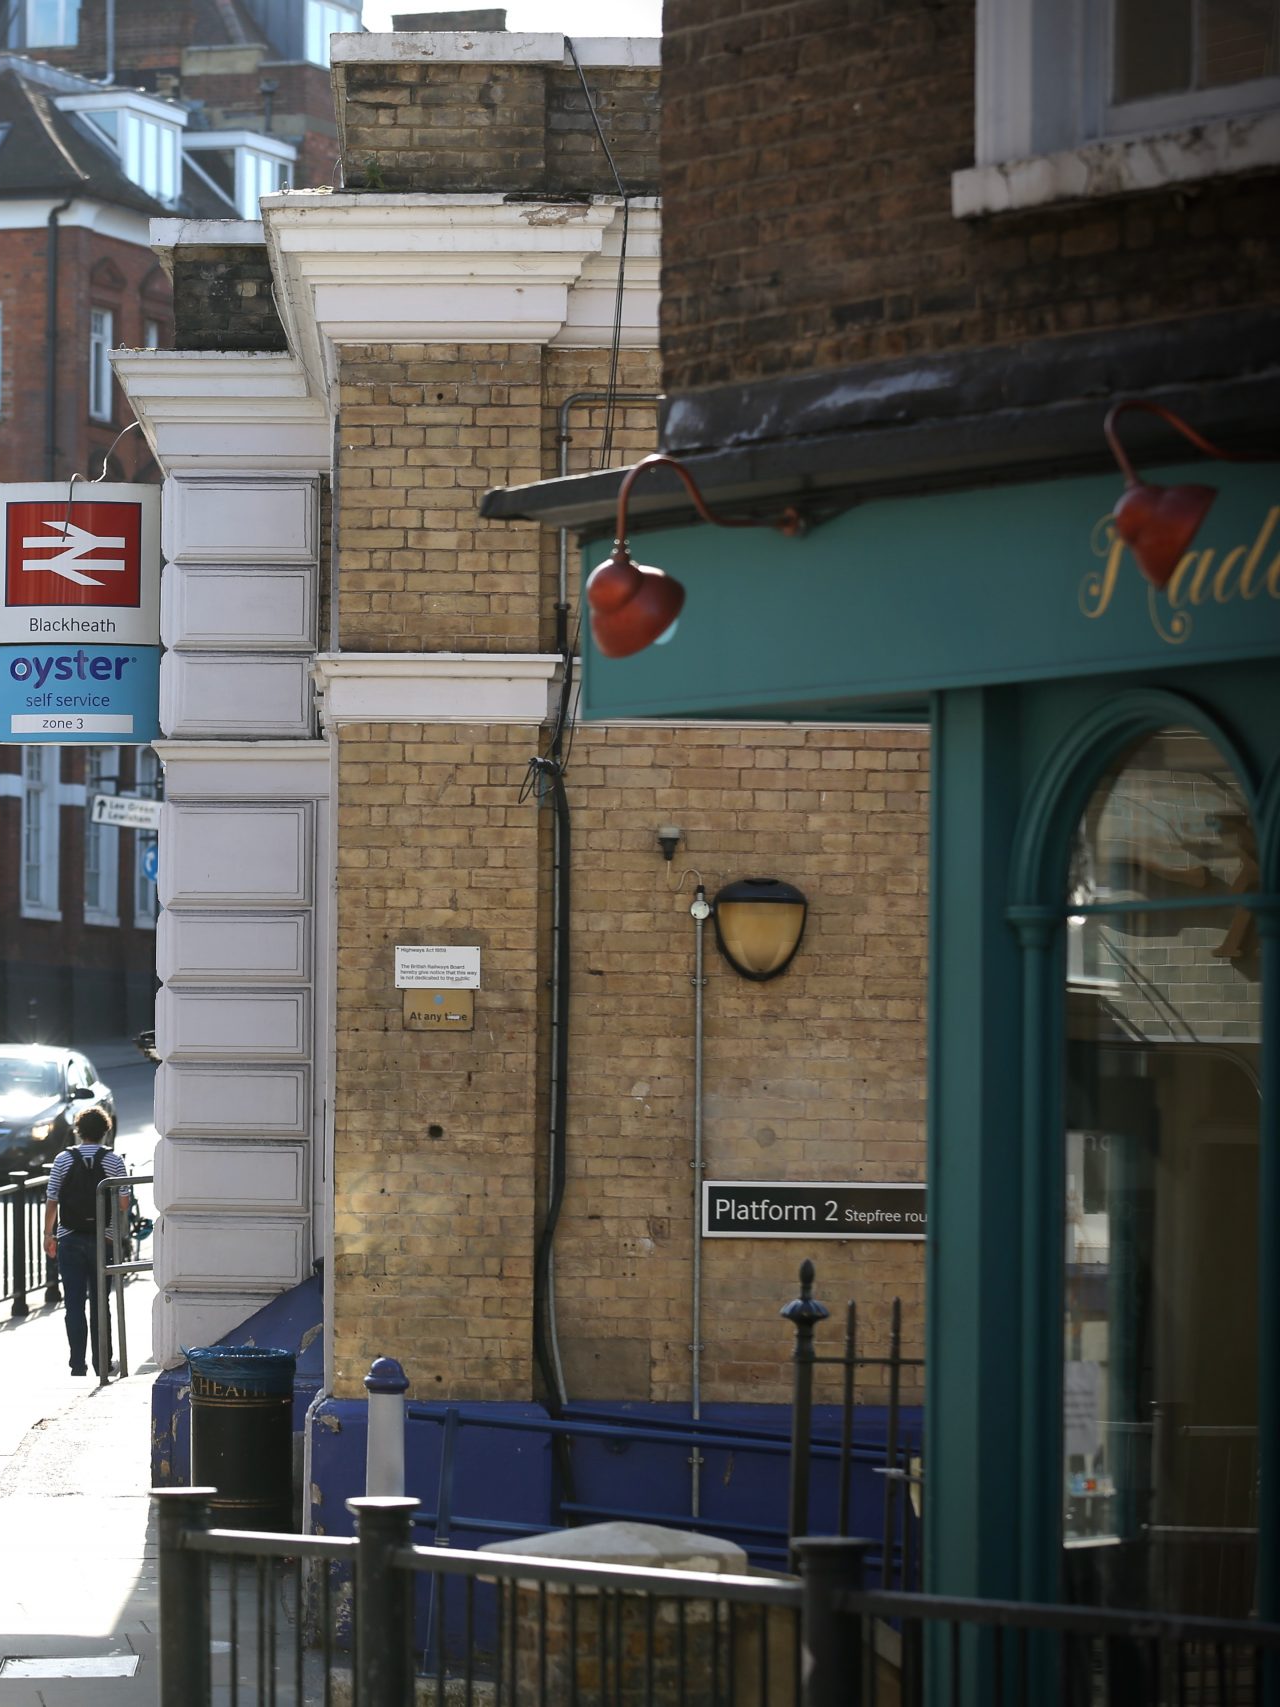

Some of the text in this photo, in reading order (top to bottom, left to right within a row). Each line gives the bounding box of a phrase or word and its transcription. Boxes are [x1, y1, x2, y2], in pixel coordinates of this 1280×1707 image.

[29, 617, 116, 633] Blackheath
[9, 649, 130, 690] oyster
[25, 692, 111, 708] self service
[42, 717, 85, 730] zone 3
[410, 1011, 423, 1021] At
[423, 1013, 442, 1023] any
[715, 1198, 817, 1222] Platform
[824, 1200, 839, 1222] 2
[844, 1209, 902, 1225] Stepfree
